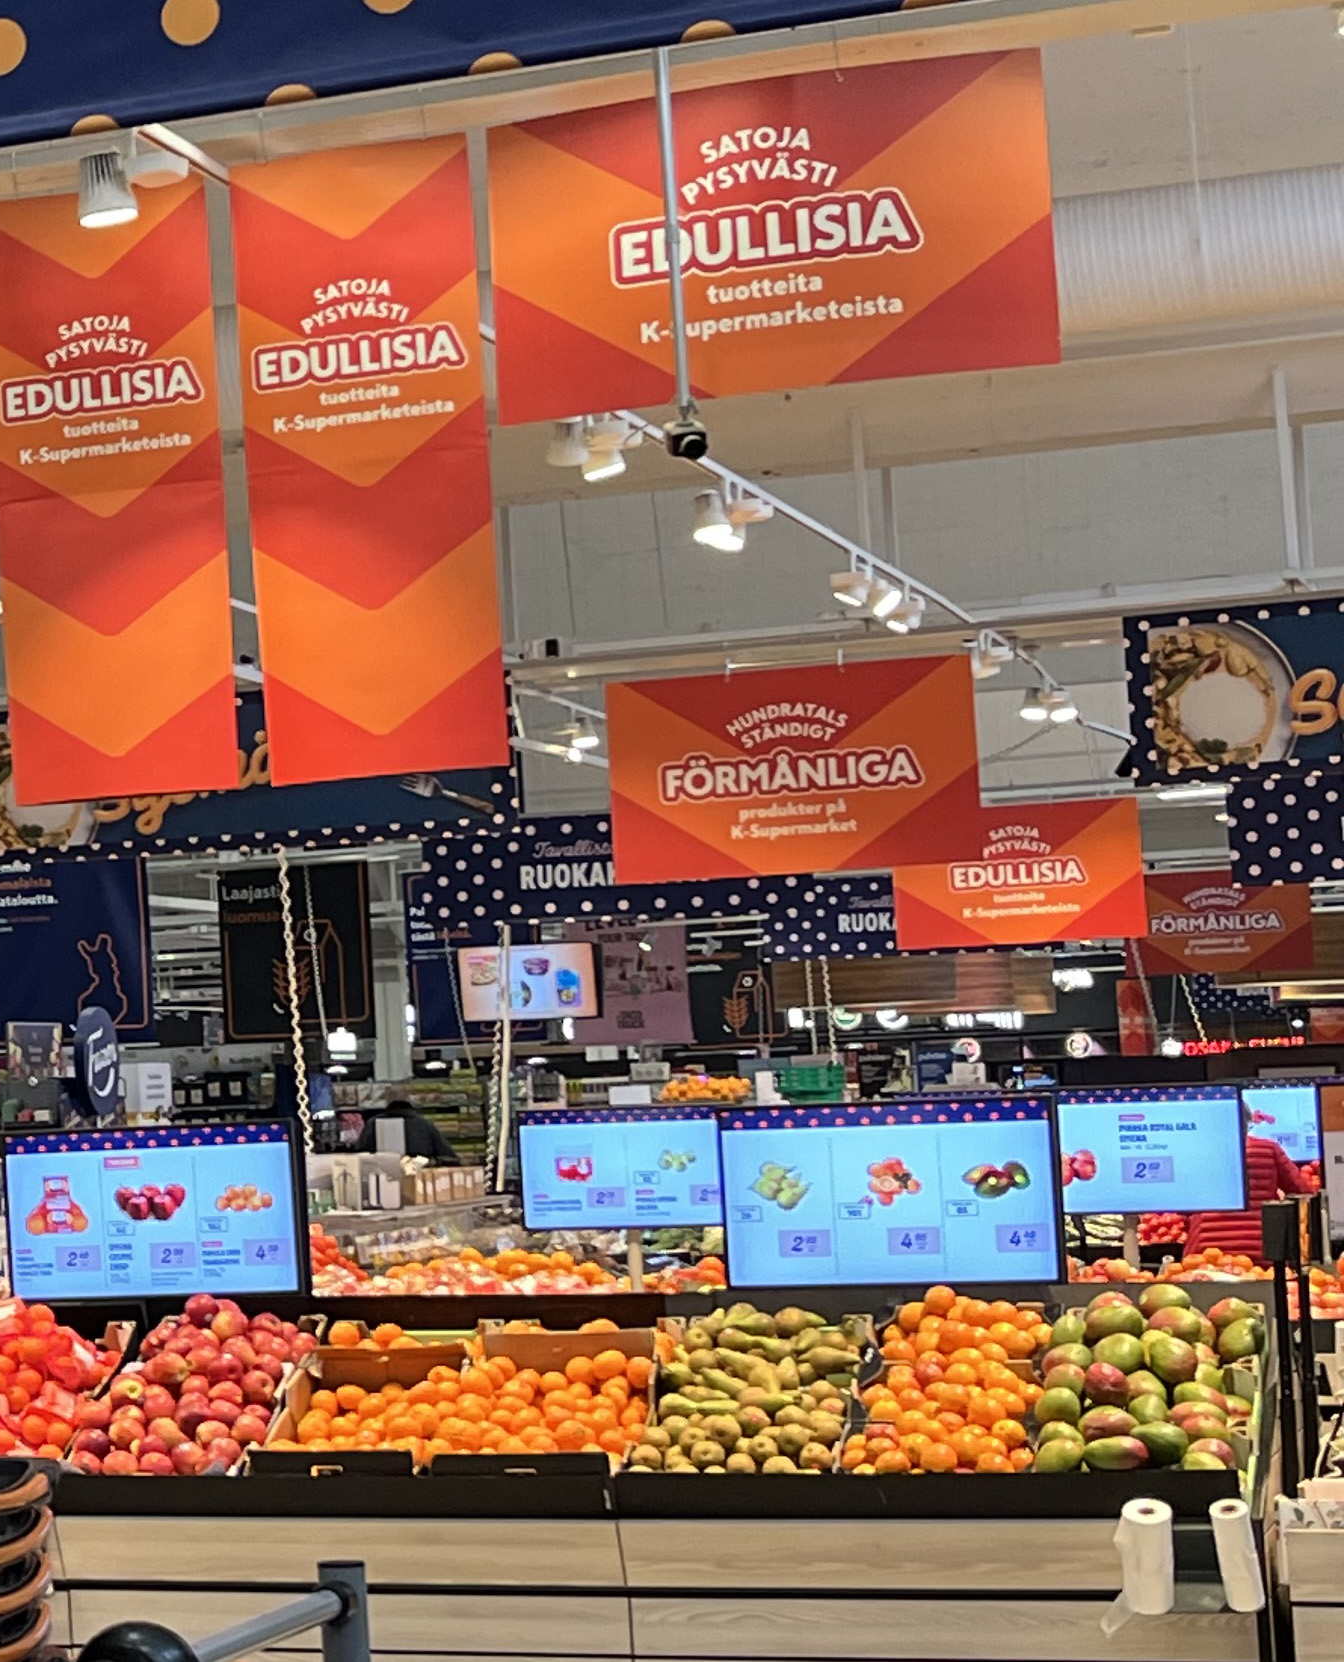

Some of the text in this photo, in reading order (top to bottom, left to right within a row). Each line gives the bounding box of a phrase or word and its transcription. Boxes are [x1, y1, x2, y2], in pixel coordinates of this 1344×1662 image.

[700, 127, 812, 163] SATOJA
[680, 153, 838, 206] PYSYVÄSTI
[620, 198, 912, 279] EDULLISIA
[314, 278, 390, 305] SATOJA
[706, 273, 824, 305] tuotteita
[58, 315, 131, 340] SATOJA
[300, 297, 410, 334] PYSYVÄSTI
[640, 294, 904, 345] K-upermarketeista
[45, 333, 148, 368] PYSYVÄSTI
[258, 329, 459, 386] EDULLISIA
[5, 365, 195, 419] EDULLISIA
[319, 384, 400, 406] tuotteita
[63, 417, 139, 438] tuotteita
[273, 399, 454, 433] K-Supermarketeista
[19, 432, 192, 465] K-Supermarketeista
[1289, 668, 1344, 735] S
[725, 702, 848, 737] HUNDRATALS
[741, 721, 836, 749] STÄNDIGT
[665, 752, 916, 798] FÖRMÅNLIGA
[739, 802, 821, 823] produkter
[988, 825, 1039, 841] SATOJA
[953, 860, 1084, 888] EDULLISIA
[1151, 912, 1280, 933] FÖRMÅNLIGA
